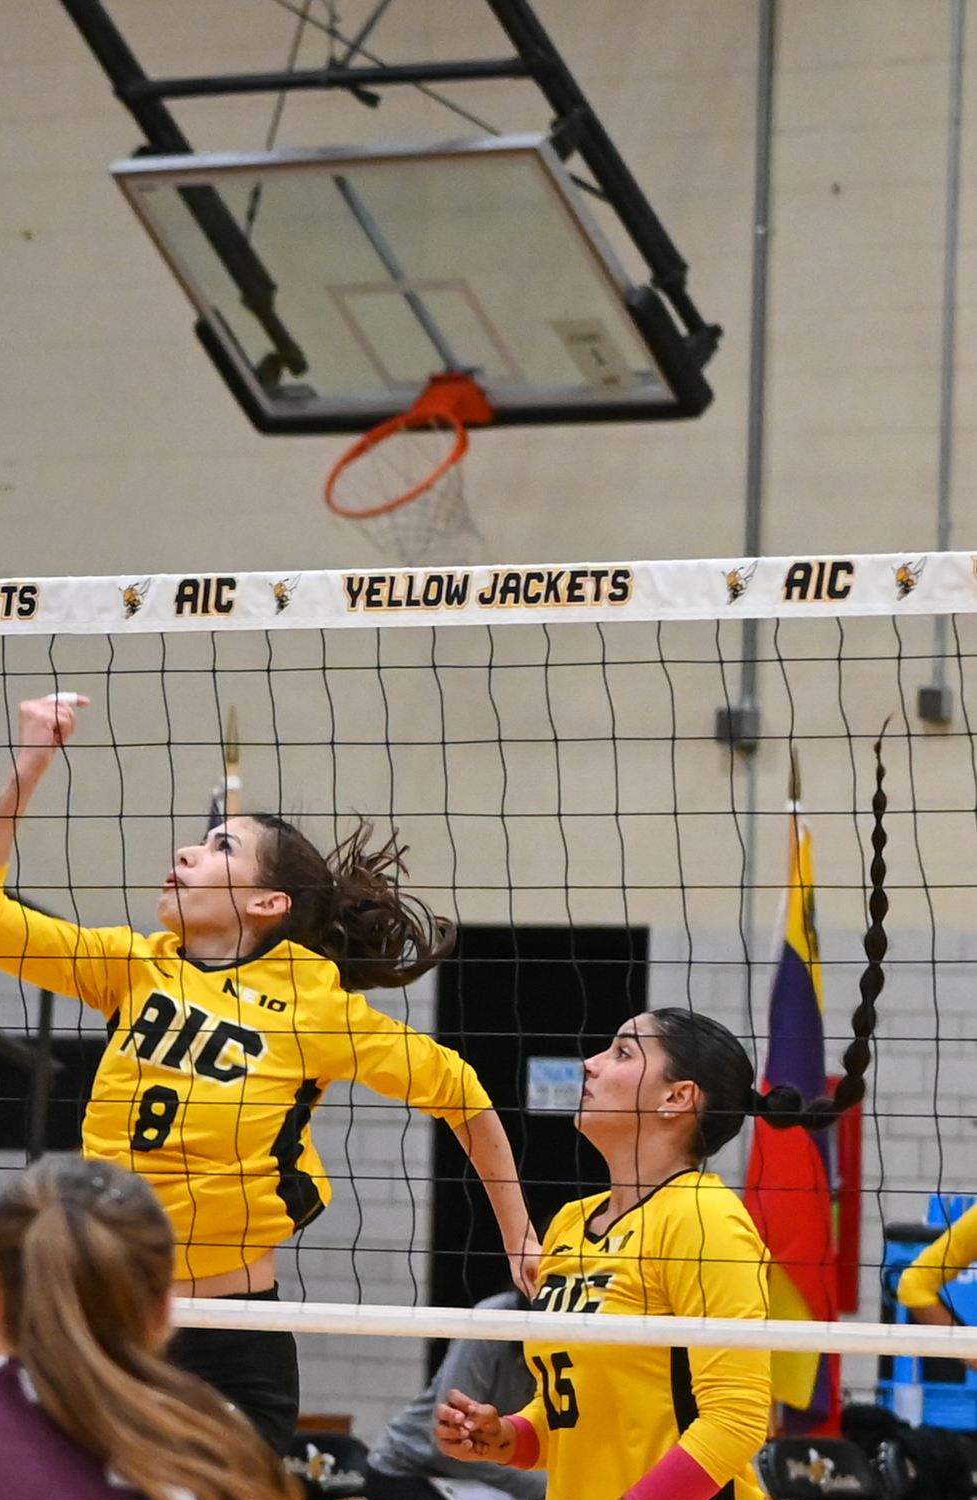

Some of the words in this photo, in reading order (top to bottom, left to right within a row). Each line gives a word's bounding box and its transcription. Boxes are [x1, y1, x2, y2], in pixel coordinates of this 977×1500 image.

[175, 576, 237, 617] AIC
[344, 573, 470, 612] YELLOW
[477, 567, 635, 606] JACKETS
[782, 560, 858, 603] AIC
[120, 990, 268, 1084] AIC
[131, 1084, 180, 1152] 8
